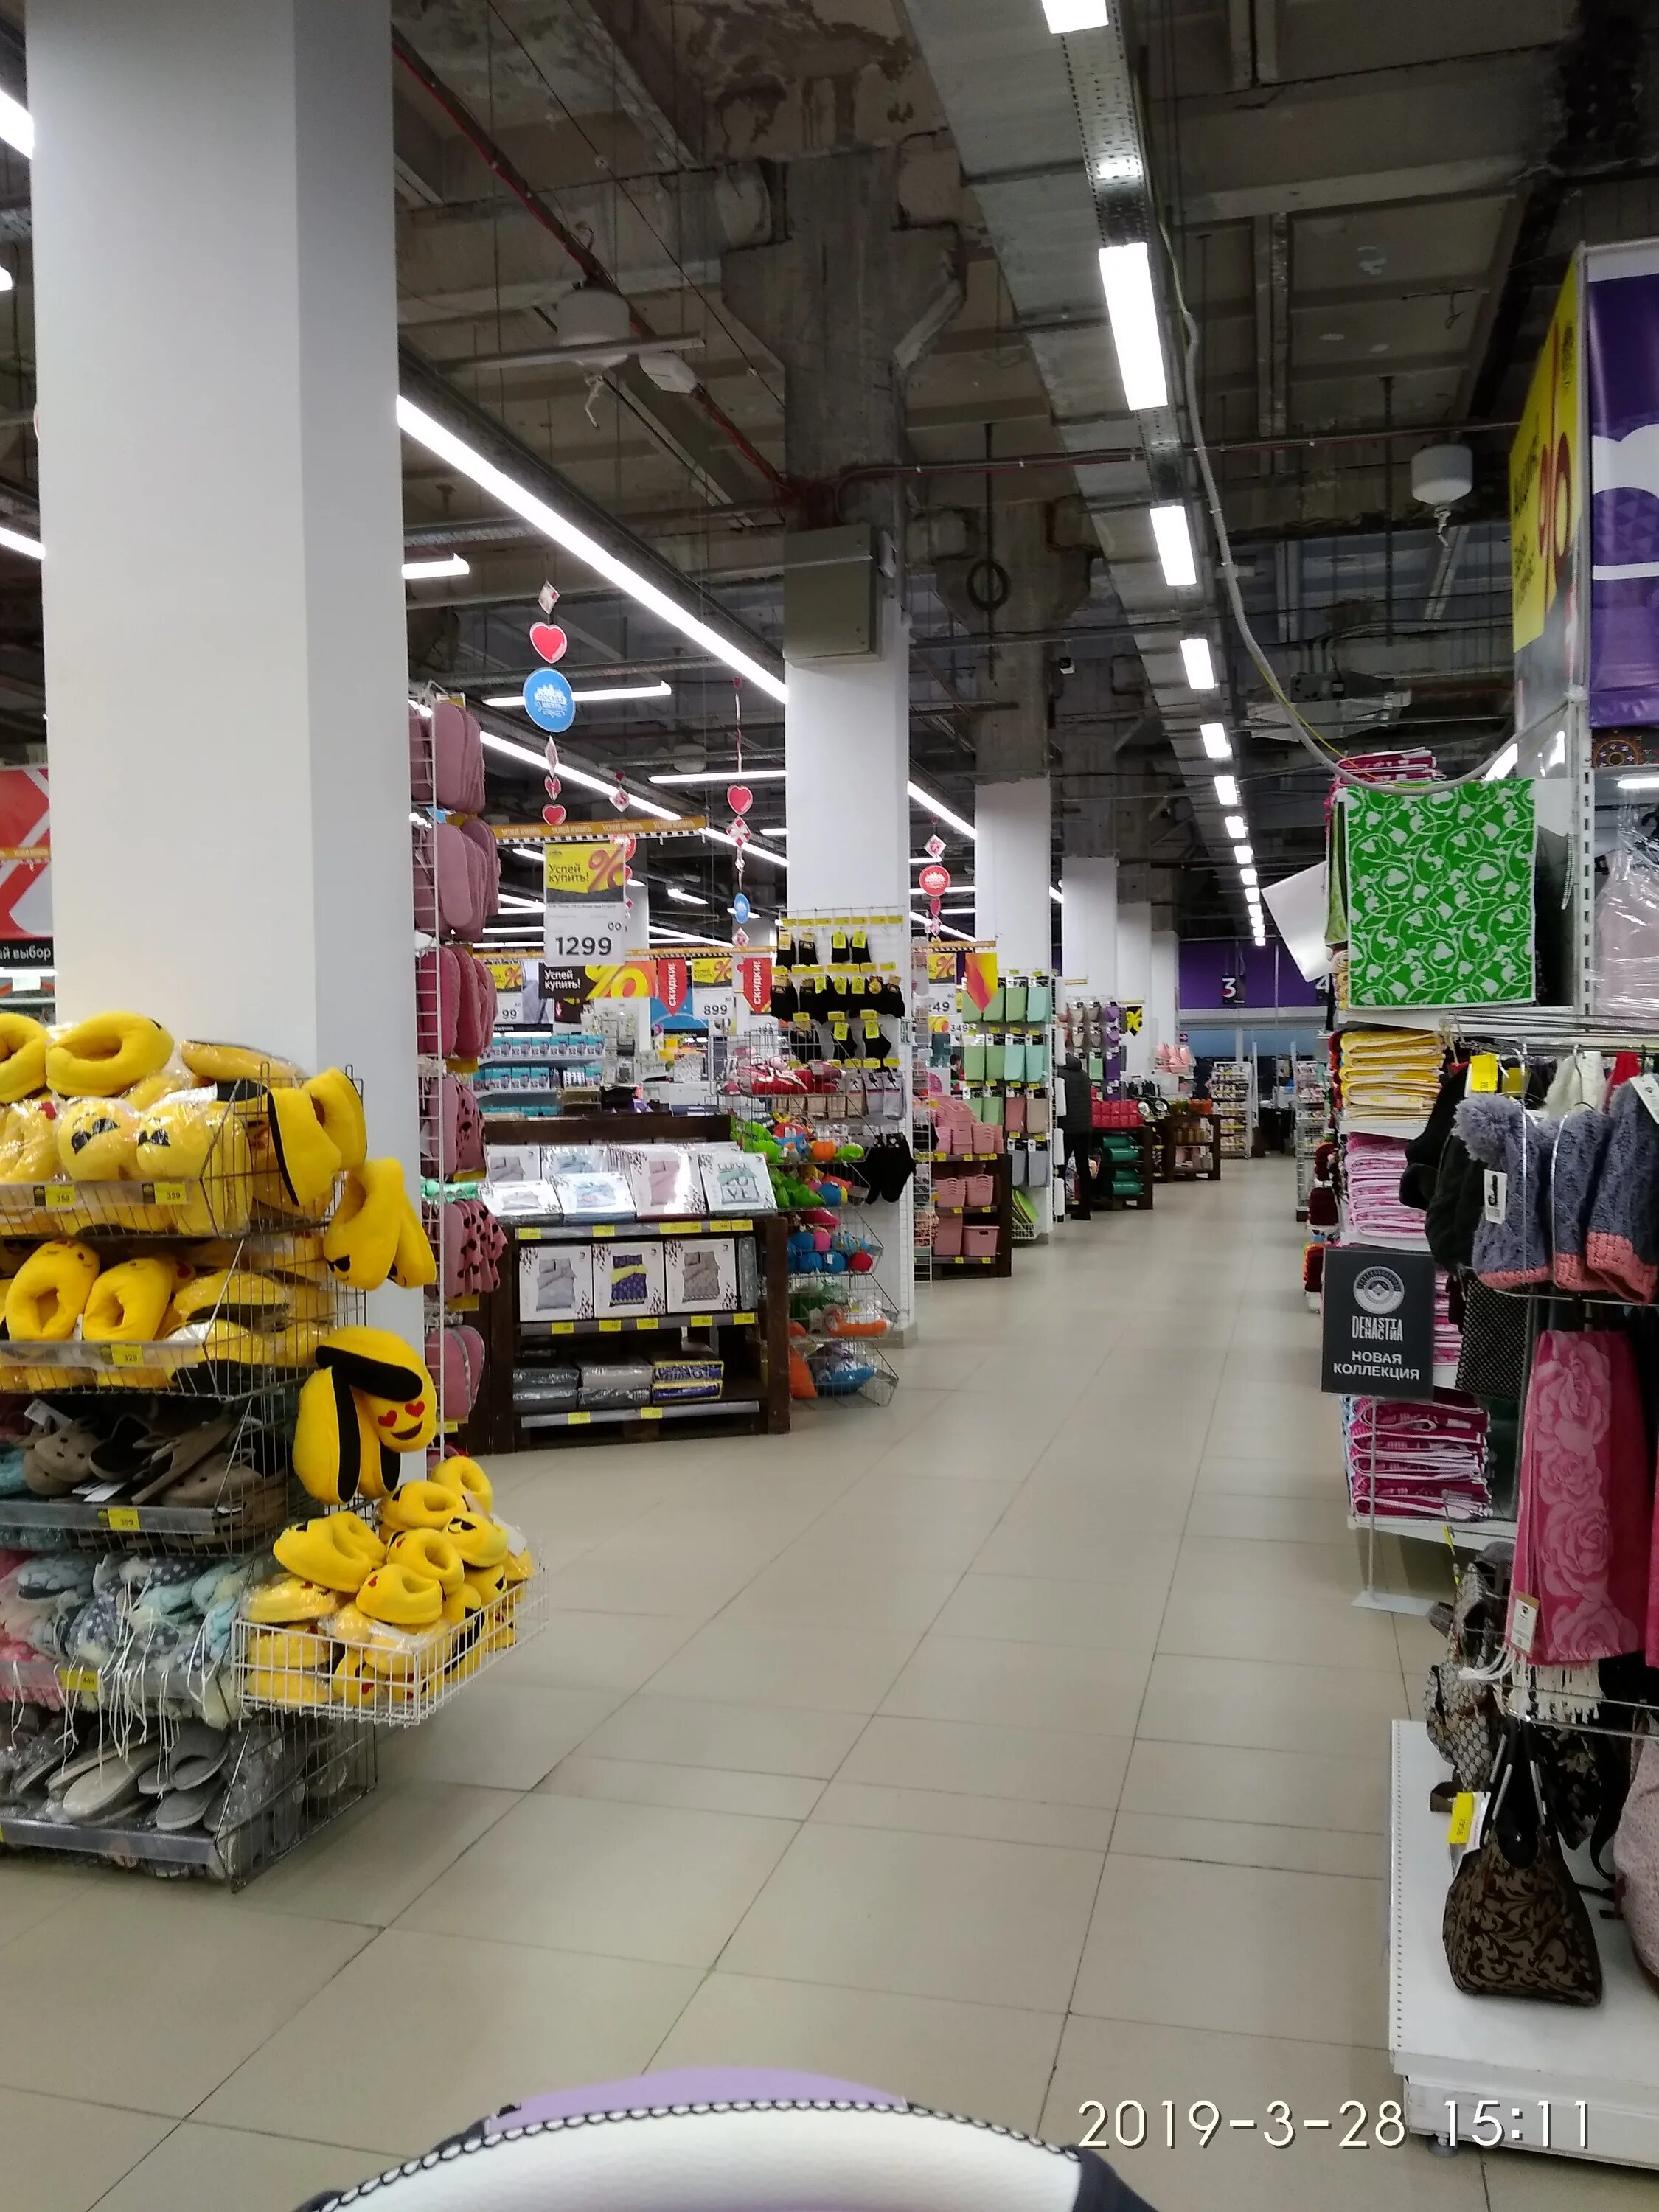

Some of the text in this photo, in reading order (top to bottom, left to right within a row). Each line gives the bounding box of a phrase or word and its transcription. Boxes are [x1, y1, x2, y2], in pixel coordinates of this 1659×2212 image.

[549, 863, 581, 875] Успей
[549, 872, 589, 885] купить!
[607, 922, 622, 931] 00
[555, 936, 612, 956] 1299
[13, 945, 51, 961] выбор
[544, 968, 574, 981] Успей
[544, 978, 581, 991] купить!
[1221, 978, 1237, 998] 3
[704, 1005, 728, 1015] 899
[1351, 1350, 1402, 1365] НОВАЯ
[1332, 1363, 1421, 1380] КОЛЛЕКЦИЯ
